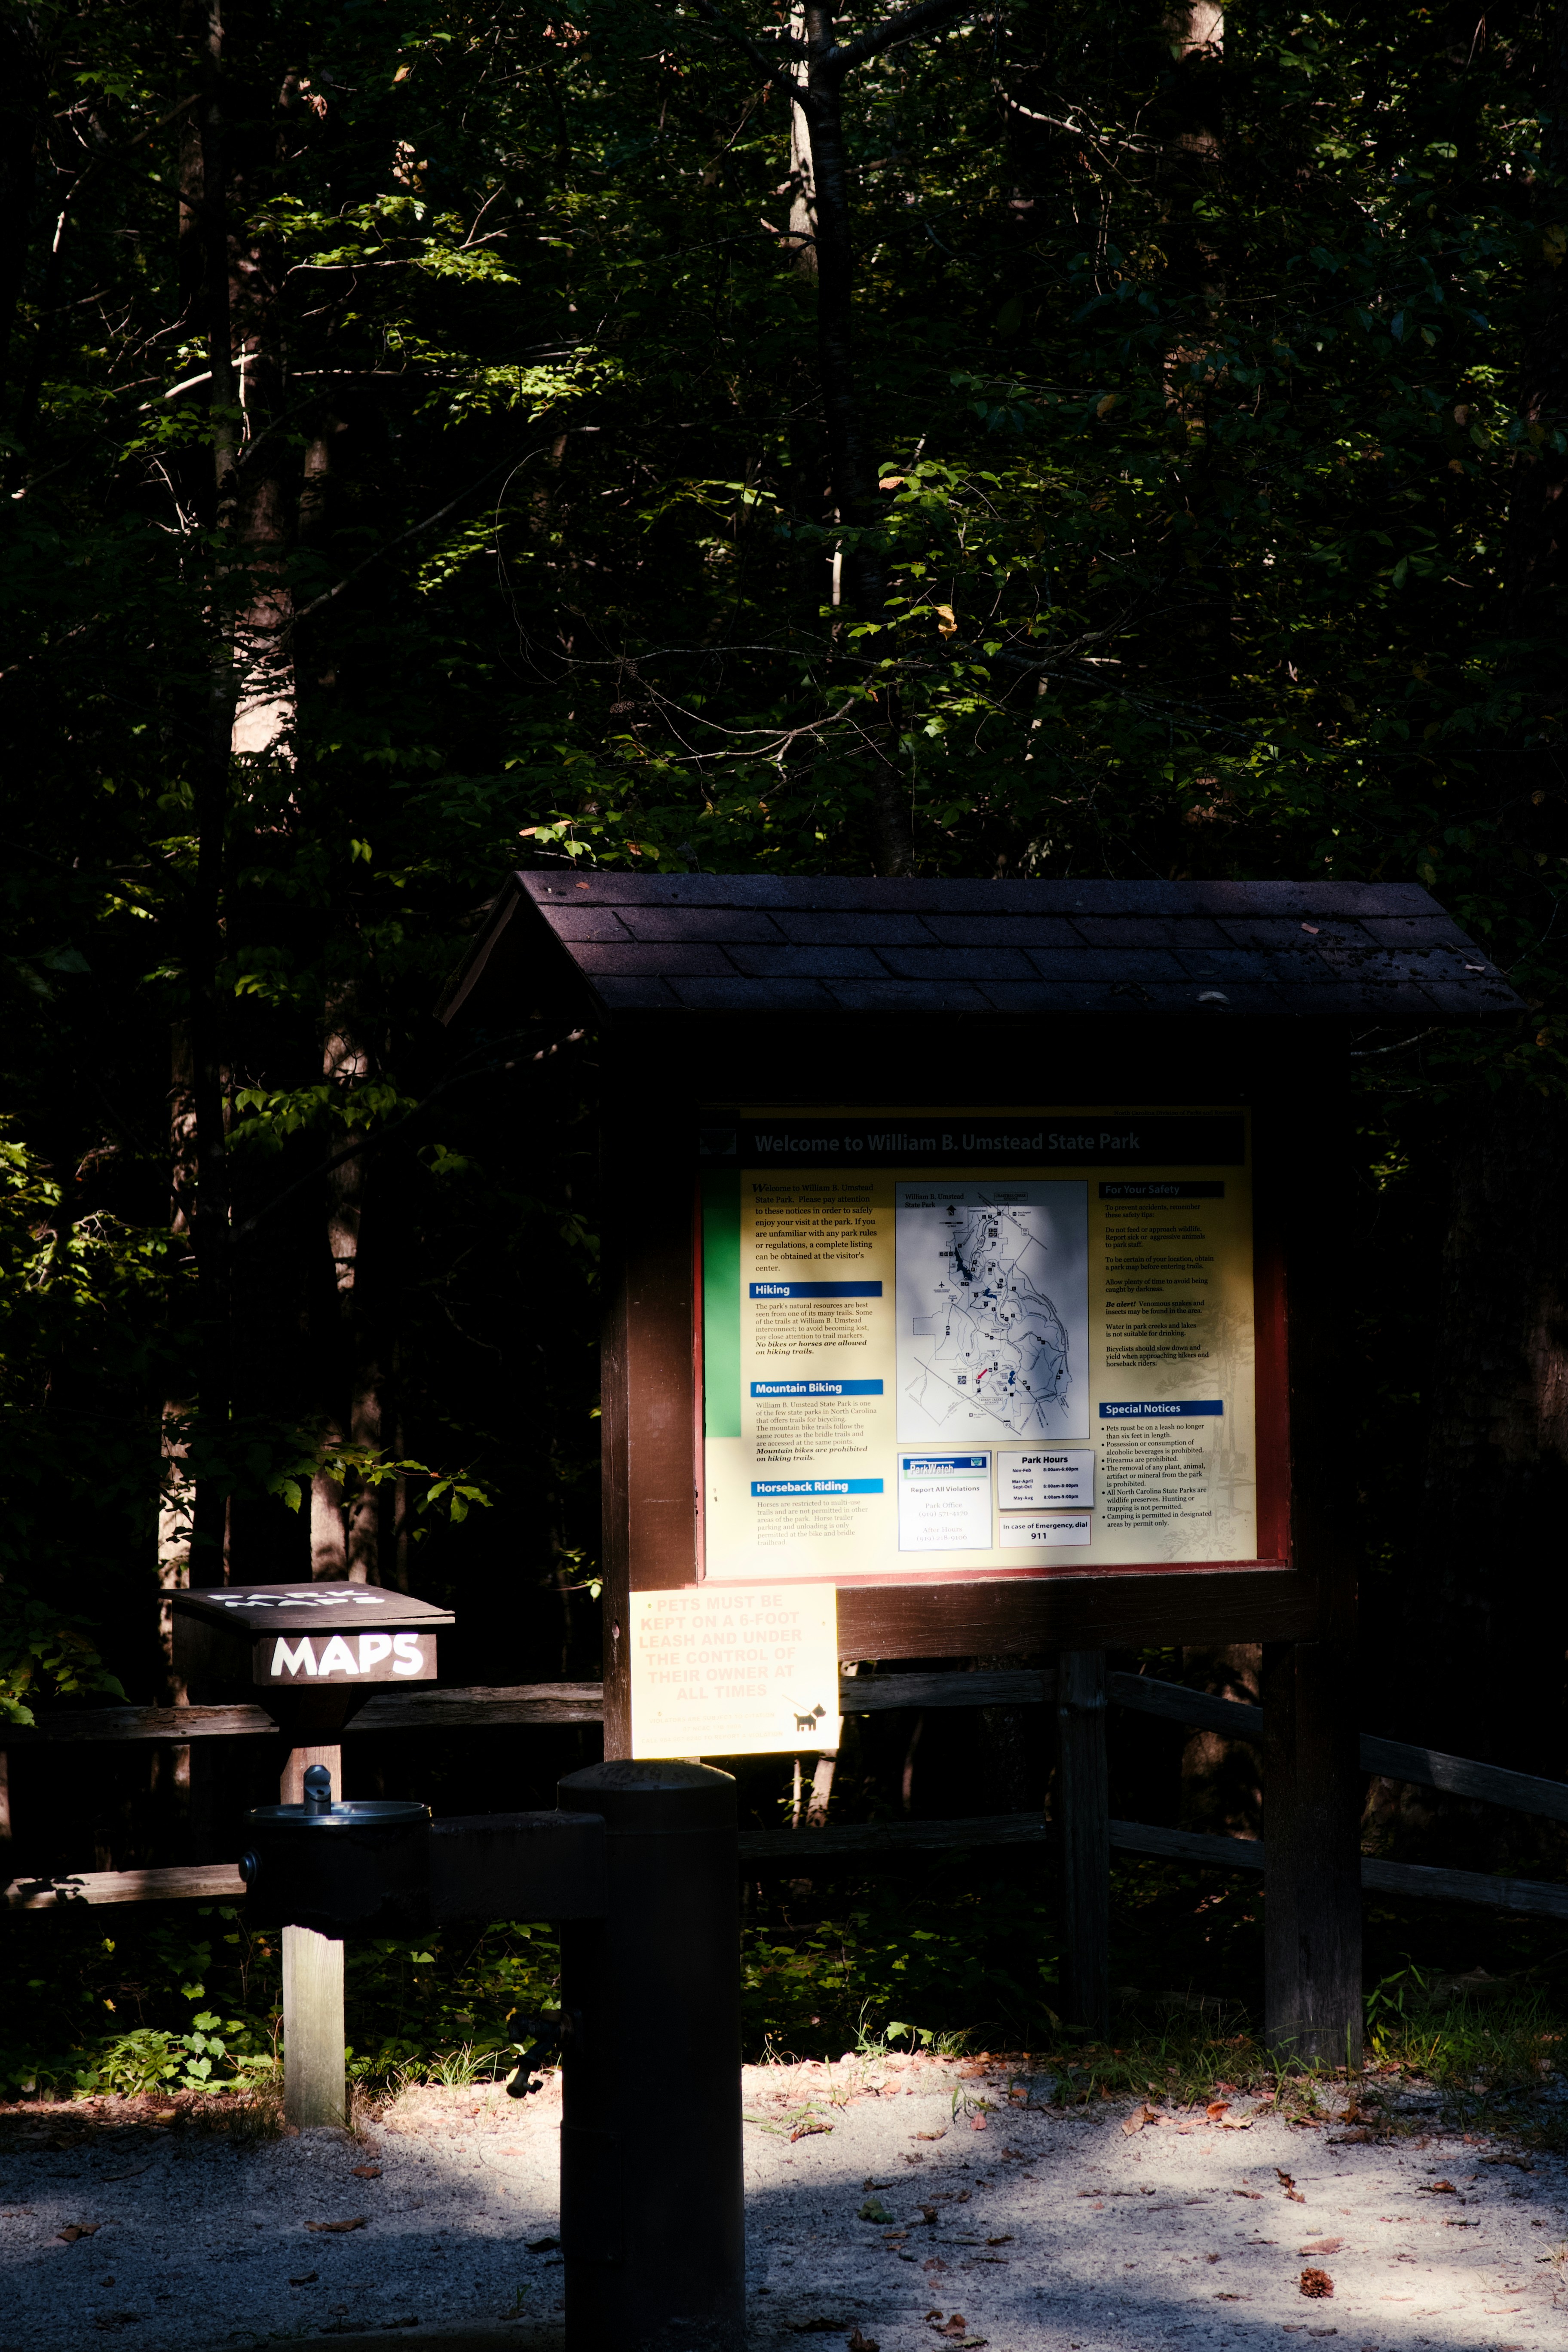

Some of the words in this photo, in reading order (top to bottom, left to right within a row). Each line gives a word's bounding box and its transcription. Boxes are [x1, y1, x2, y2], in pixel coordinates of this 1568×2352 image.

[755, 1135, 839, 1151] Welcome
[844, 1137, 863, 1151] to
[867, 1134, 935, 1150] William
[943, 1135, 958, 1150] B.
[963, 1133, 1042, 1150] Umstead
[1049, 1134, 1094, 1149] State
[1100, 1133, 1139, 1148] Park
[1149, 1185, 1179, 1195] Safety
[756, 1219, 775, 1227] enjoy
[835, 1218, 852, 1226] park.
[842, 1229, 857, 1237] park
[756, 1285, 789, 1296] Hiking
[756, 1384, 806, 1393] Mountain
[809, 1383, 842, 1393] Biking
[1106, 1405, 1141, 1415] Special
[1145, 1404, 1180, 1412] Notices
[910, 1464, 954, 1474] ParkWatch
[757, 1482, 812, 1492] Horseback
[815, 1481, 848, 1492] Riding
[207, 1590, 369, 1600] PARK
[224, 1597, 385, 1607] MAPS
[658, 1598, 700, 1611] PETS
[707, 1596, 755, 1609] MUST
[761, 1595, 782, 1607] BE
[641, 1617, 686, 1630] KEPT
[692, 1616, 716, 1628] ON
[723, 1615, 734, 1626] A
[740, 1611, 799, 1626] 6-FOOT
[640, 1634, 695, 1648] LEASH
[701, 1632, 736, 1645] AND
[744, 1629, 802, 1643] UNDER
[271, 1632, 424, 1676] MAPS
[646, 1653, 680, 1666] THE
[687, 1649, 768, 1664] CONTROL
[775, 1647, 795, 1659] OF
[648, 1670, 700, 1683] THEIR
[707, 1666, 769, 1681] OWNER
[775, 1665, 794, 1677] AT
[677, 1687, 708, 1700] ALL
[714, 1684, 766, 1698] TIMES
